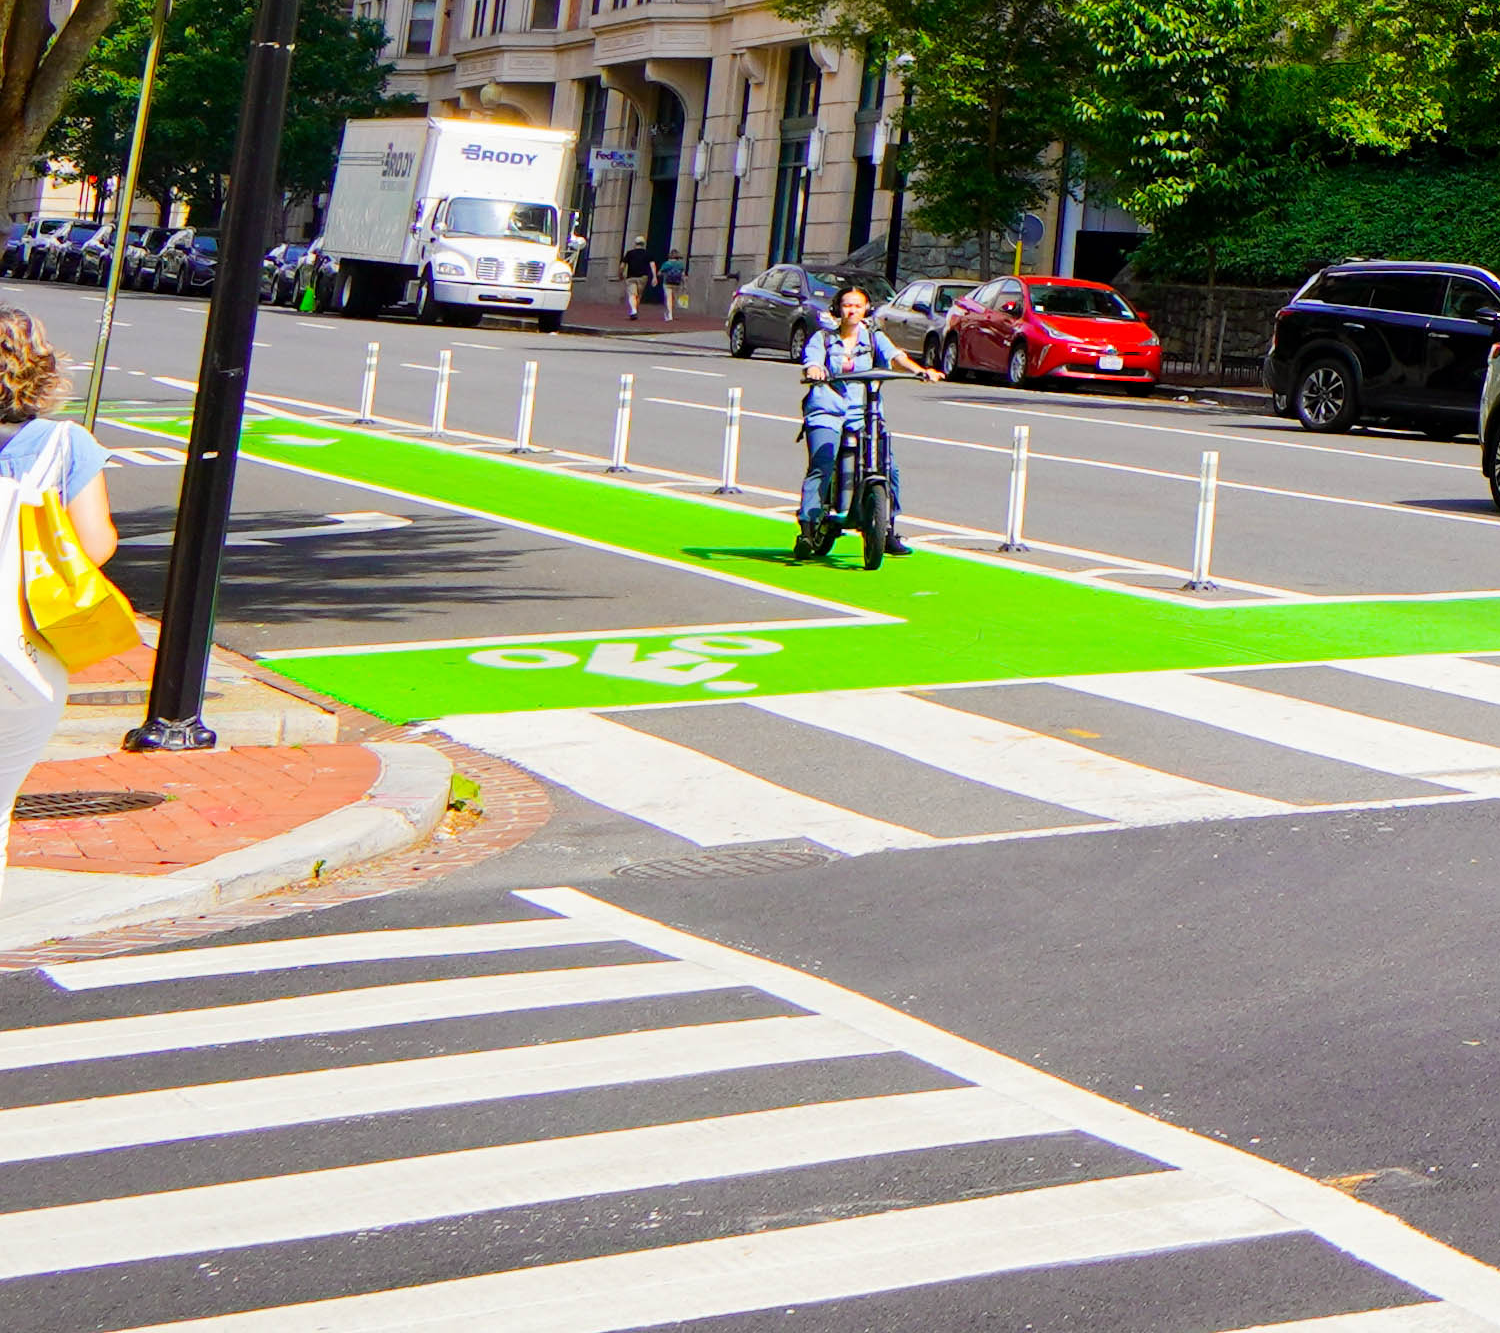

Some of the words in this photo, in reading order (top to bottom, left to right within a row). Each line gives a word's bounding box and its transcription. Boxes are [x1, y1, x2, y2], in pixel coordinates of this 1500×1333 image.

[382, 142, 416, 177] BRODY
[462, 144, 538, 166] BRODY
[596, 151, 625, 160] FedEx
